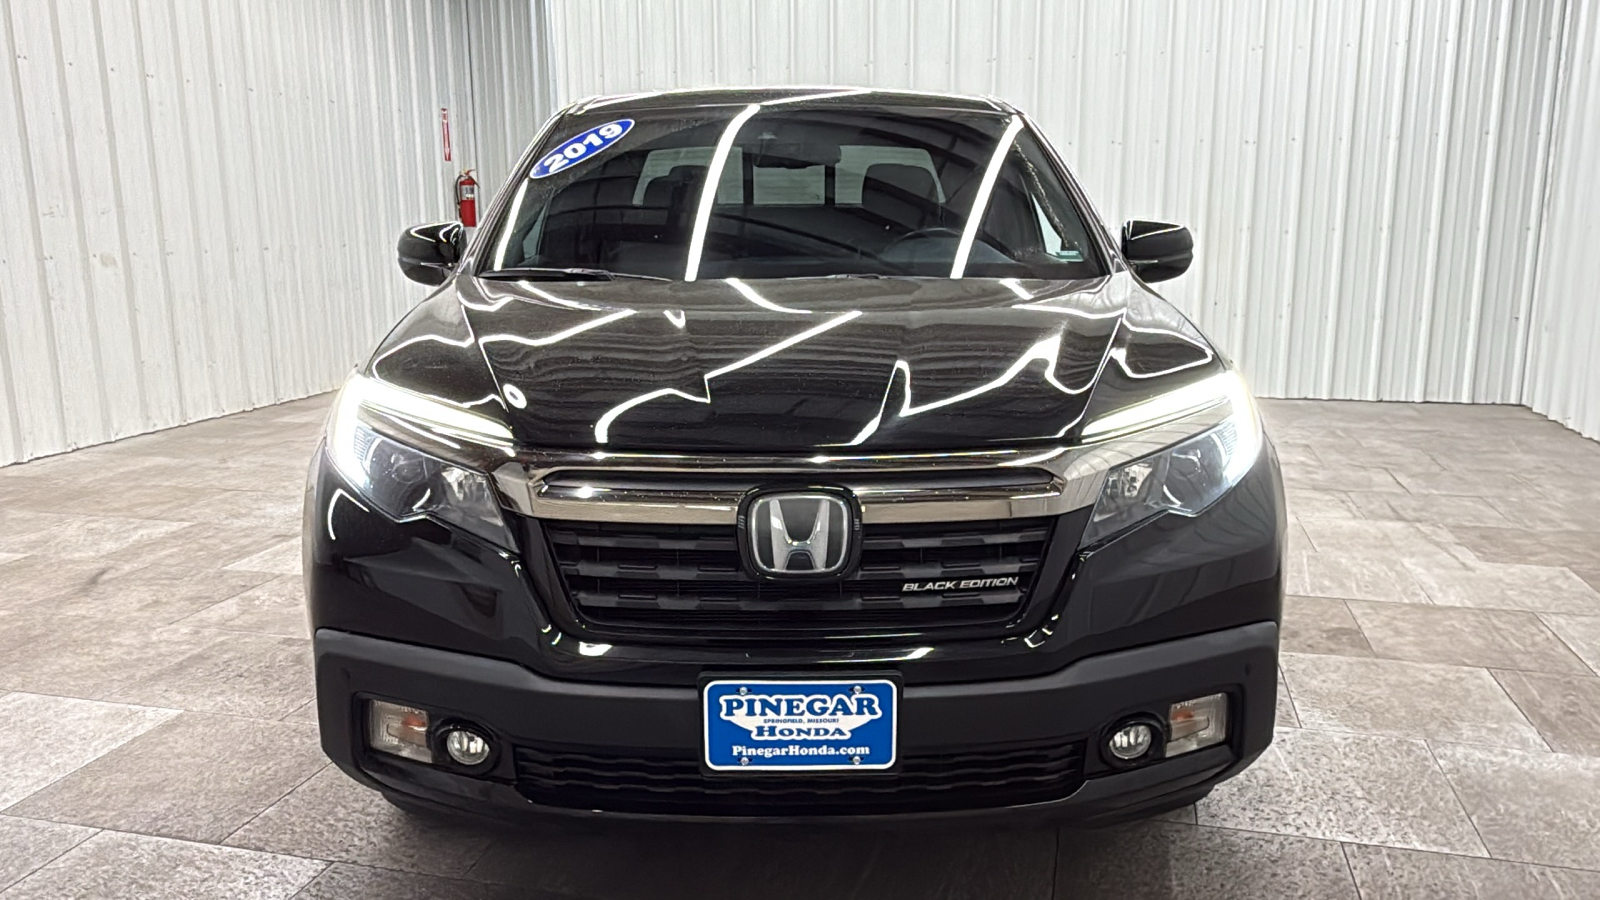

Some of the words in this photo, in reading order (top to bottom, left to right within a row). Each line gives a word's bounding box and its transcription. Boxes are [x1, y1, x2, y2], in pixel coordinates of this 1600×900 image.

[543, 123, 623, 174] 2019
[902, 581, 957, 592] BLACK
[959, 576, 1019, 589] EDITION
[723, 697, 879, 717] PINEGAR
[732, 744, 870, 758] PinegarHonda.com
